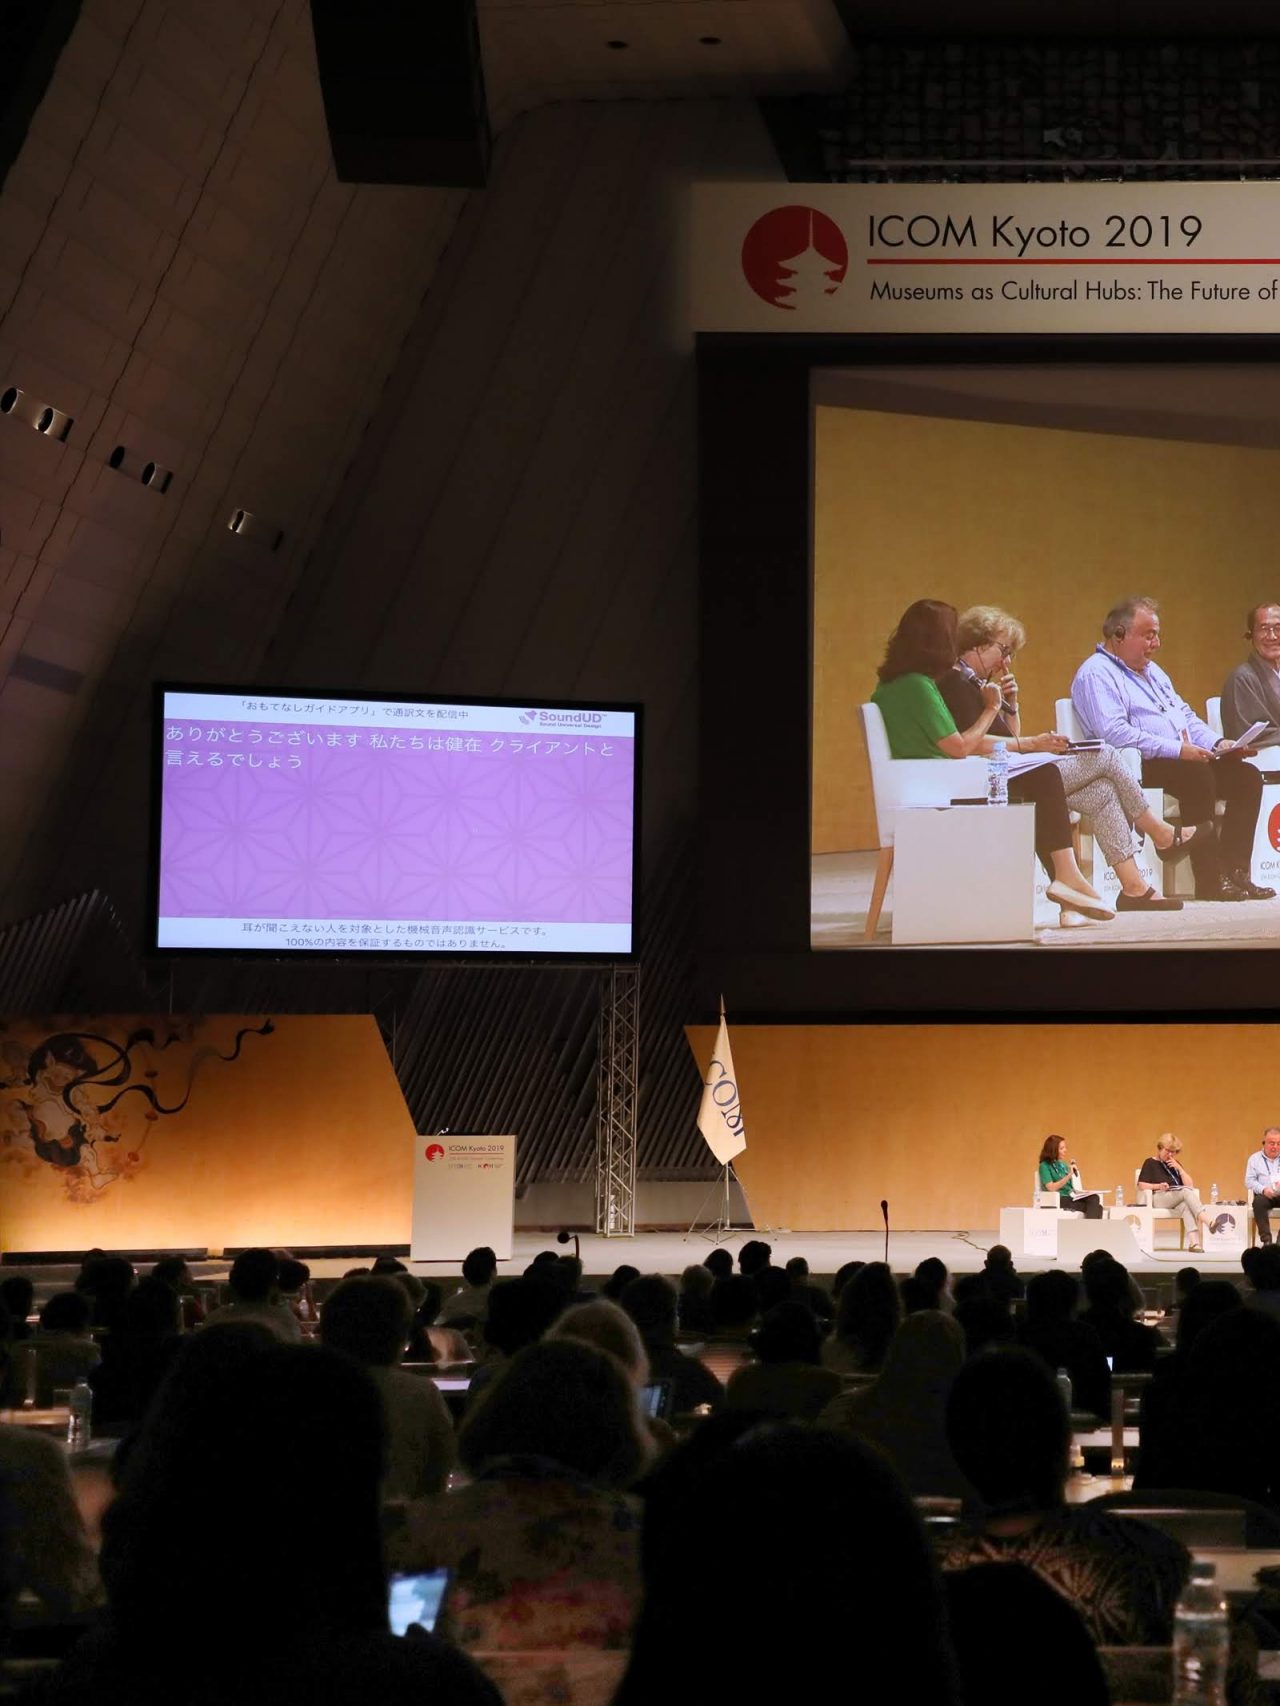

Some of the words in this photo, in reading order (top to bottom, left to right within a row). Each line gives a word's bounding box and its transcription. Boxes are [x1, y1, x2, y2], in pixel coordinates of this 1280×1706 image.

[867, 214, 977, 249] ICOM
[991, 214, 1091, 258] Kyoto
[1104, 214, 1203, 249] 2019
[869, 280, 964, 302] Museums
[971, 286, 995, 302] as
[1001, 280, 1078, 302] Cultural
[1085, 280, 1142, 302] Hubs:
[1147, 280, 1184, 302] The
[1191, 280, 1251, 302] Future
[1258, 280, 1280, 301] of
[166, 725, 362, 748] ありがとうございます
[370, 733, 482, 753] 私たちは健在
[489, 738, 615, 757] クライアントと
[166, 750, 302, 769] 言えるでしょう
